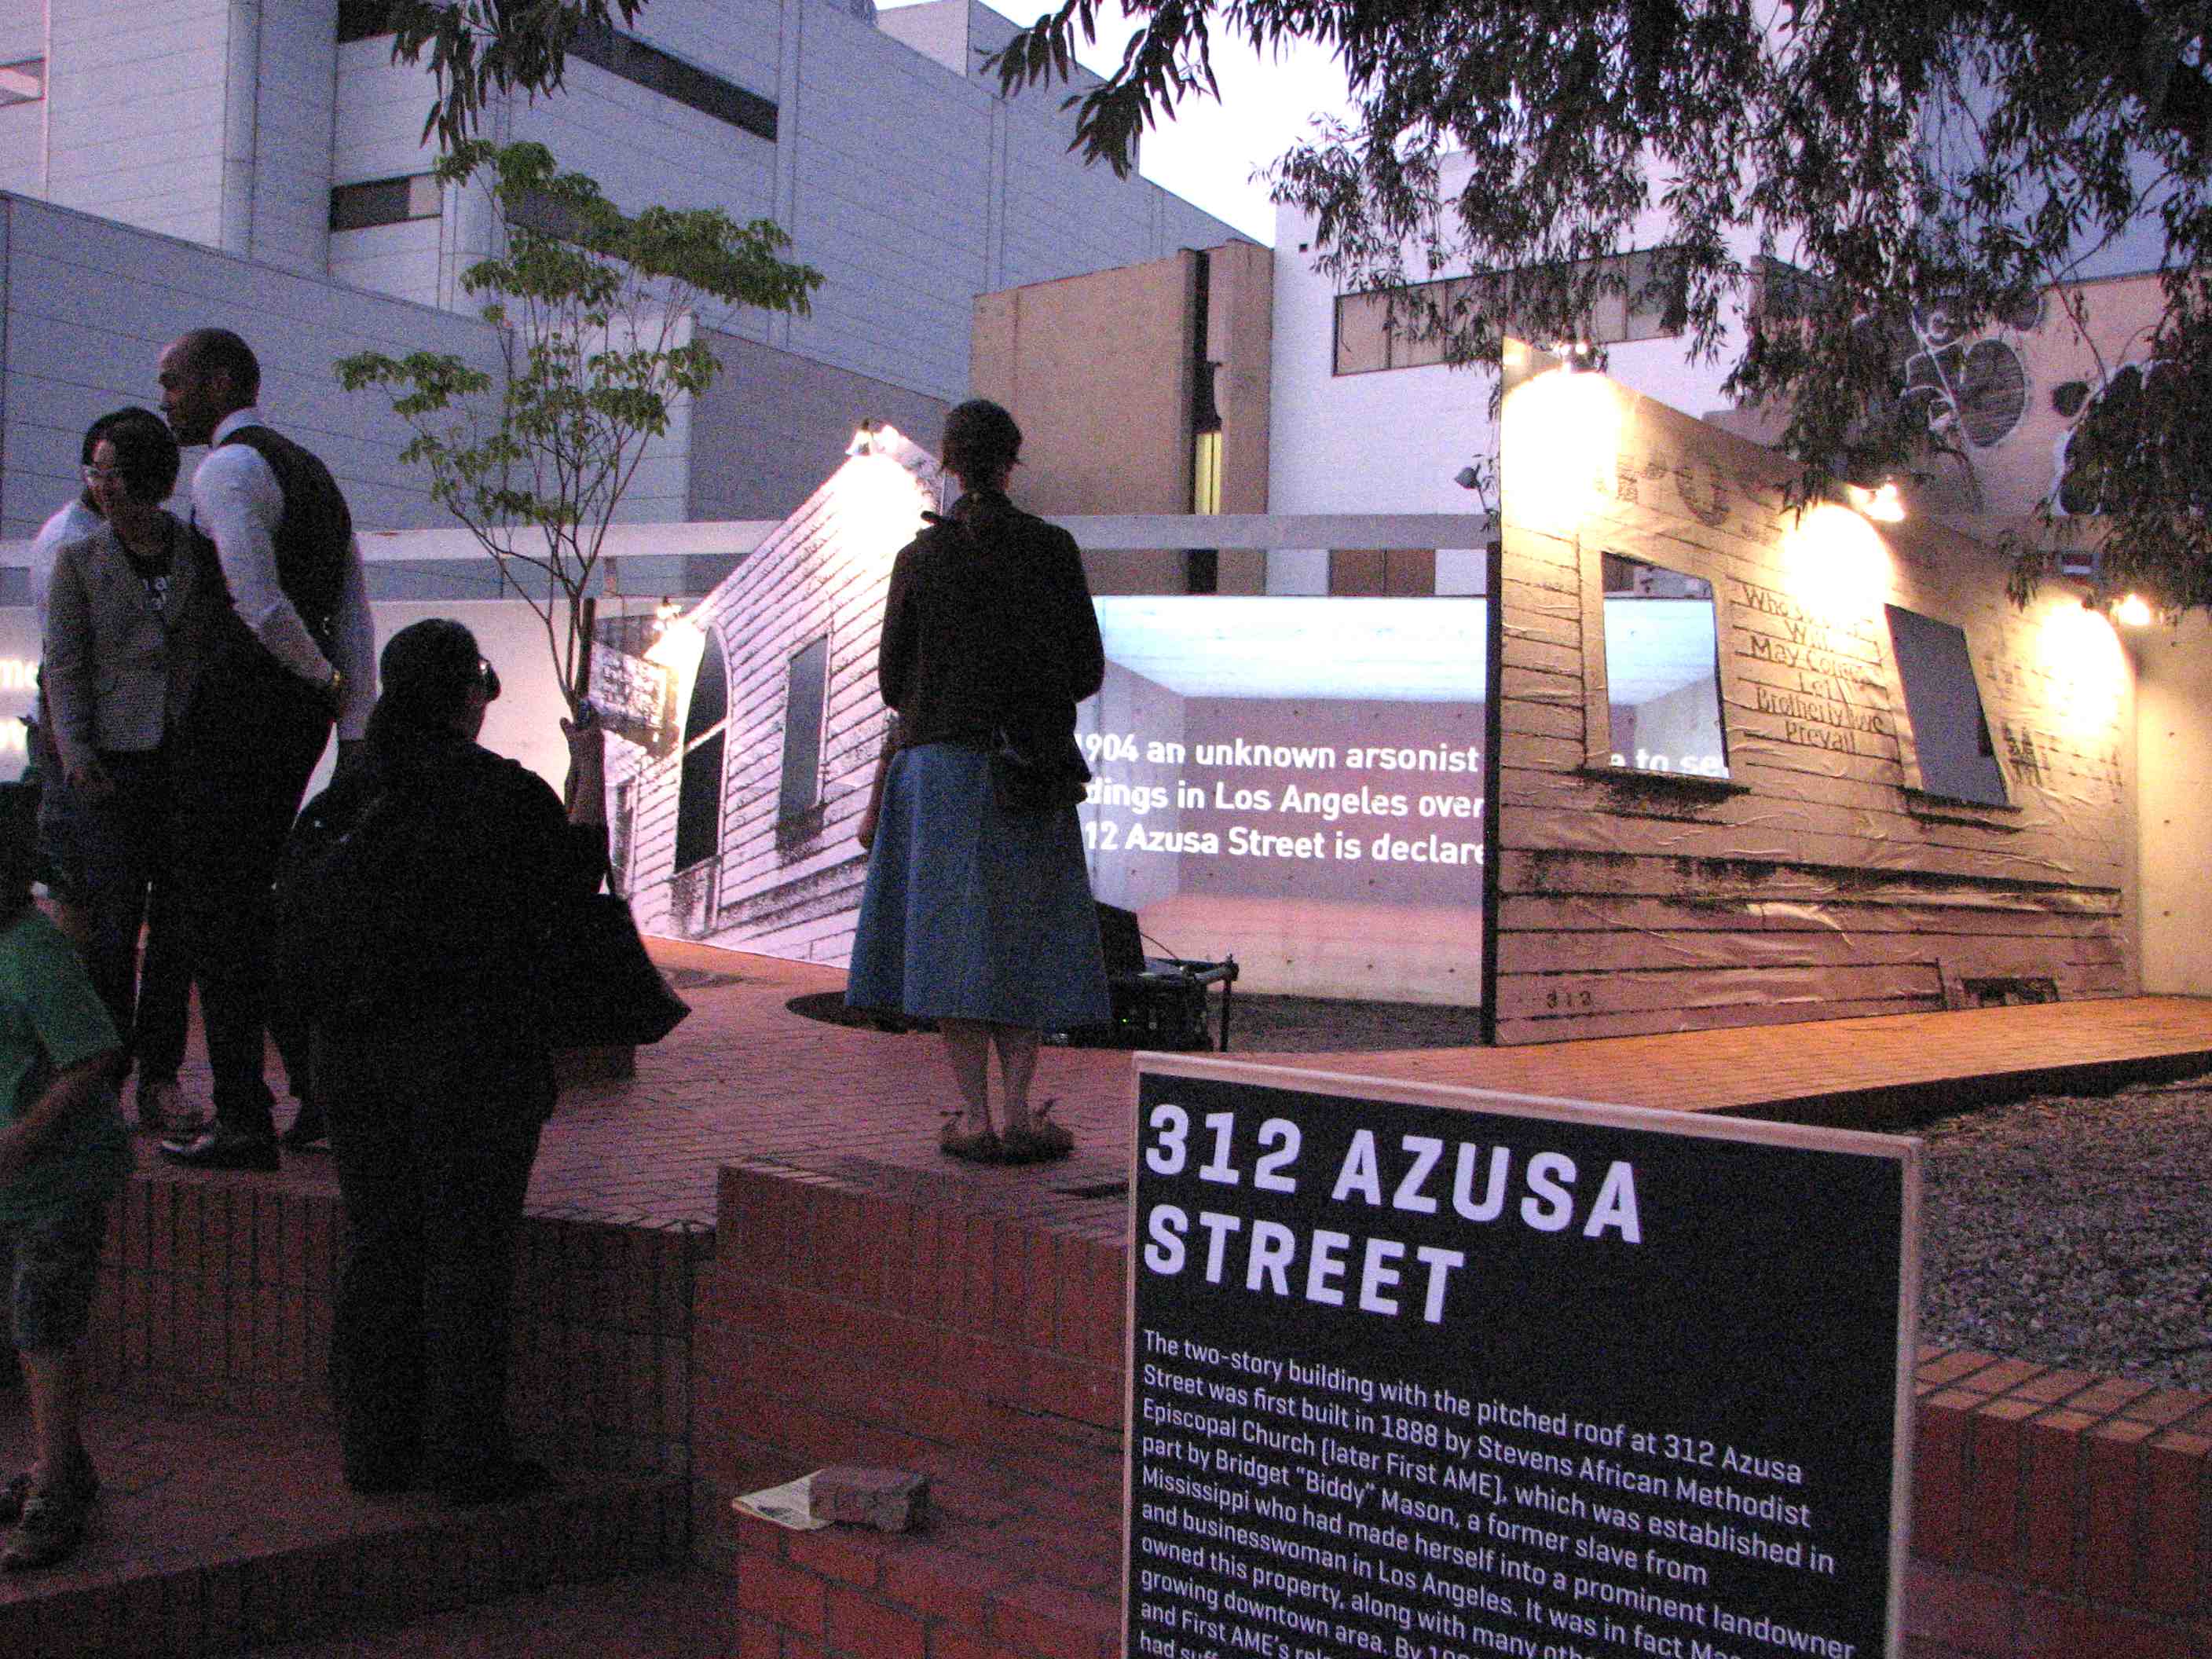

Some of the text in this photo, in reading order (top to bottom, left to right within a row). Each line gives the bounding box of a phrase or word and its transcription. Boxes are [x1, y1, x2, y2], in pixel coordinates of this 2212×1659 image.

[1751, 635, 1800, 668] May
[1147, 742, 1185, 764] an
[1195, 738, 1335, 769] unknown
[1346, 743, 1478, 772] arsonist
[1784, 720, 1855, 754] Prevail
[1085, 777, 1484, 820] dings in Los Angeles over
[1086, 821, 1119, 850] 12
[1125, 823, 1218, 855] Azusa
[1228, 826, 1325, 859] Street
[1335, 831, 1361, 859] is
[1145, 1104, 1643, 1243] 312 AZUSA
[1144, 1203, 1464, 1324] STREET
[1144, 1330, 1802, 1484] The two-story building with the pitched roof at 312 Azusa
[1144, 1364, 1811, 1529] Street was first built in 1888 by Stevens African Methodist
[1143, 1397, 1236, 1438] Episcopal
[1242, 1420, 1315, 1457] Church
[1386, 1452, 1437, 1485] First
[1515, 1485, 1586, 1518] which
[1592, 1503, 1640, 1531] was
[1648, 1515, 1800, 1567] established
[1810, 1545, 1834, 1574] in
[1143, 1436, 1182, 1459] part
[1188, 1442, 1210, 1470] by
[1216, 1448, 1290, 1486] Bridget
[1381, 1489, 1459, 1530] Mason,
[1467, 1514, 1480, 1532] a
[1488, 1513, 1569, 1552] former
[1575, 1536, 1638, 1570] slave
[1646, 1549, 1708, 1586] from
[1141, 1535, 1203, 1567] owned
[1210, 1552, 1247, 1580] this
[1253, 1566, 1345, 1610] property,
[1351, 1592, 1412, 1630] along
[1418, 1611, 1465, 1640] with
[1473, 1625, 1536, 1659] many
[1141, 1569, 1218, 1610] growing
[1224, 1589, 1328, 1638] downtown
[1335, 1624, 1387, 1654] area.
[1141, 1602, 1176, 1627] and
[1181, 1610, 1225, 1643] First
[1142, 1502, 1177, 1527] and
[1183, 1508, 1346, 1572] businesswoman
[1353, 1552, 1372, 1580] in
[1379, 1559, 1416, 1590] Los
[1423, 1572, 1518, 1617] Angeles.
[1526, 1597, 1542, 1623] It
[1549, 1607, 1597, 1636] was
[1605, 1617, 1626, 1644] in
[1634, 1624, 1683, 1659] fact
[1143, 1465, 1855, 1659] Mississippi who had made herself into a prominent landowner
[1141, 1630, 1175, 1659] had
